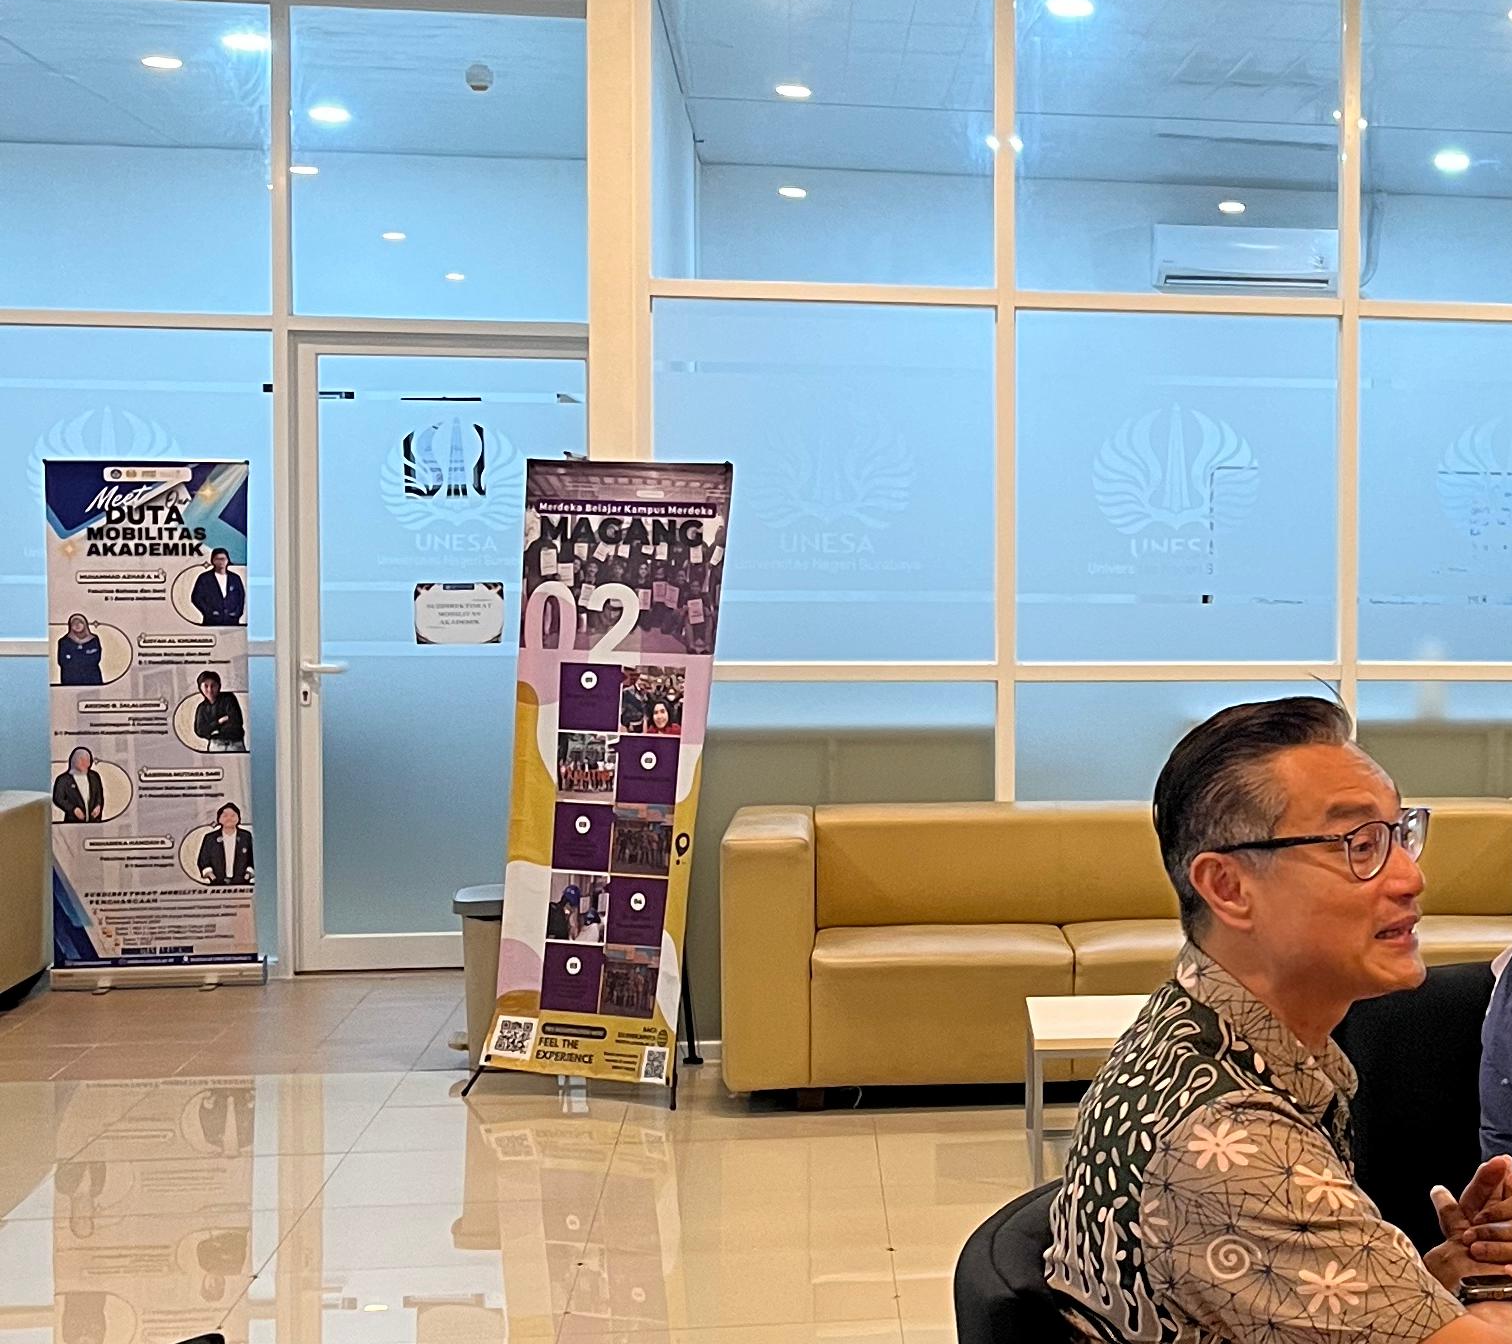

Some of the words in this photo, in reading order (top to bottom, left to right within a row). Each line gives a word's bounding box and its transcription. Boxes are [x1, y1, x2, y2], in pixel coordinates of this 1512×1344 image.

[85, 485, 151, 513] Meet
[106, 506, 184, 525] DUTA
[539, 502, 582, 513] Merdeka
[585, 503, 622, 515] Belajar
[624, 504, 666, 517] Kampus
[668, 505, 714, 516] Merdeka
[87, 527, 207, 541] MOBILITAS
[540, 515, 704, 547] MAGANG
[87, 542, 206, 557] AKADEMIK
[415, 534, 498, 552] UNESA
[779, 532, 875, 554] UNESA
[524, 580, 641, 664] 02
[538, 1037, 561, 1049] FEEL
[562, 1038, 580, 1050] THE
[535, 1049, 594, 1065] EXPERIENCE
